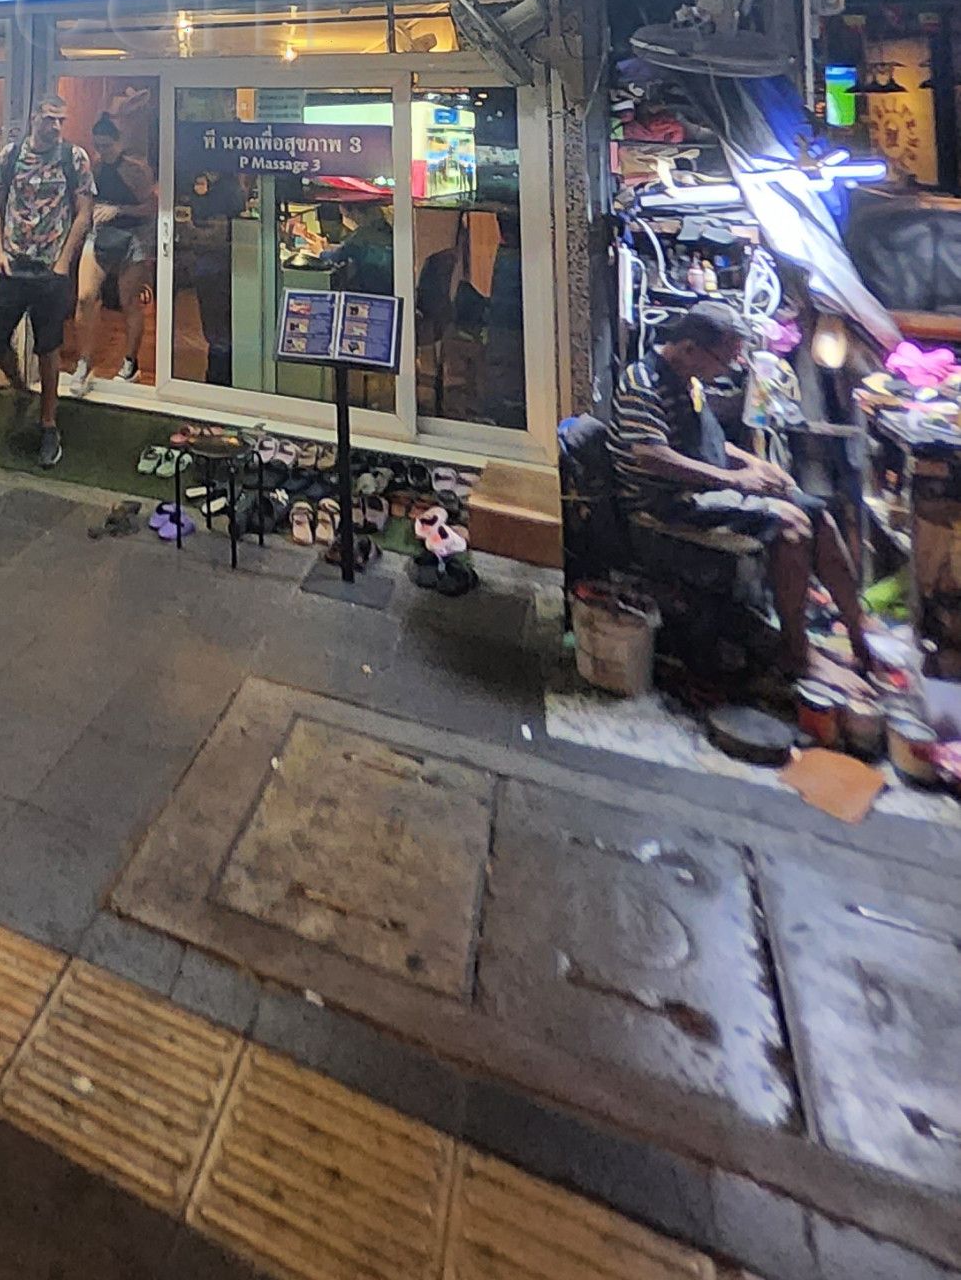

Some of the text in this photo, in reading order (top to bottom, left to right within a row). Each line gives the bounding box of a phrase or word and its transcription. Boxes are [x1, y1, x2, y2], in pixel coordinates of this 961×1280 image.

[239, 156, 321, 173] P Massage 3
